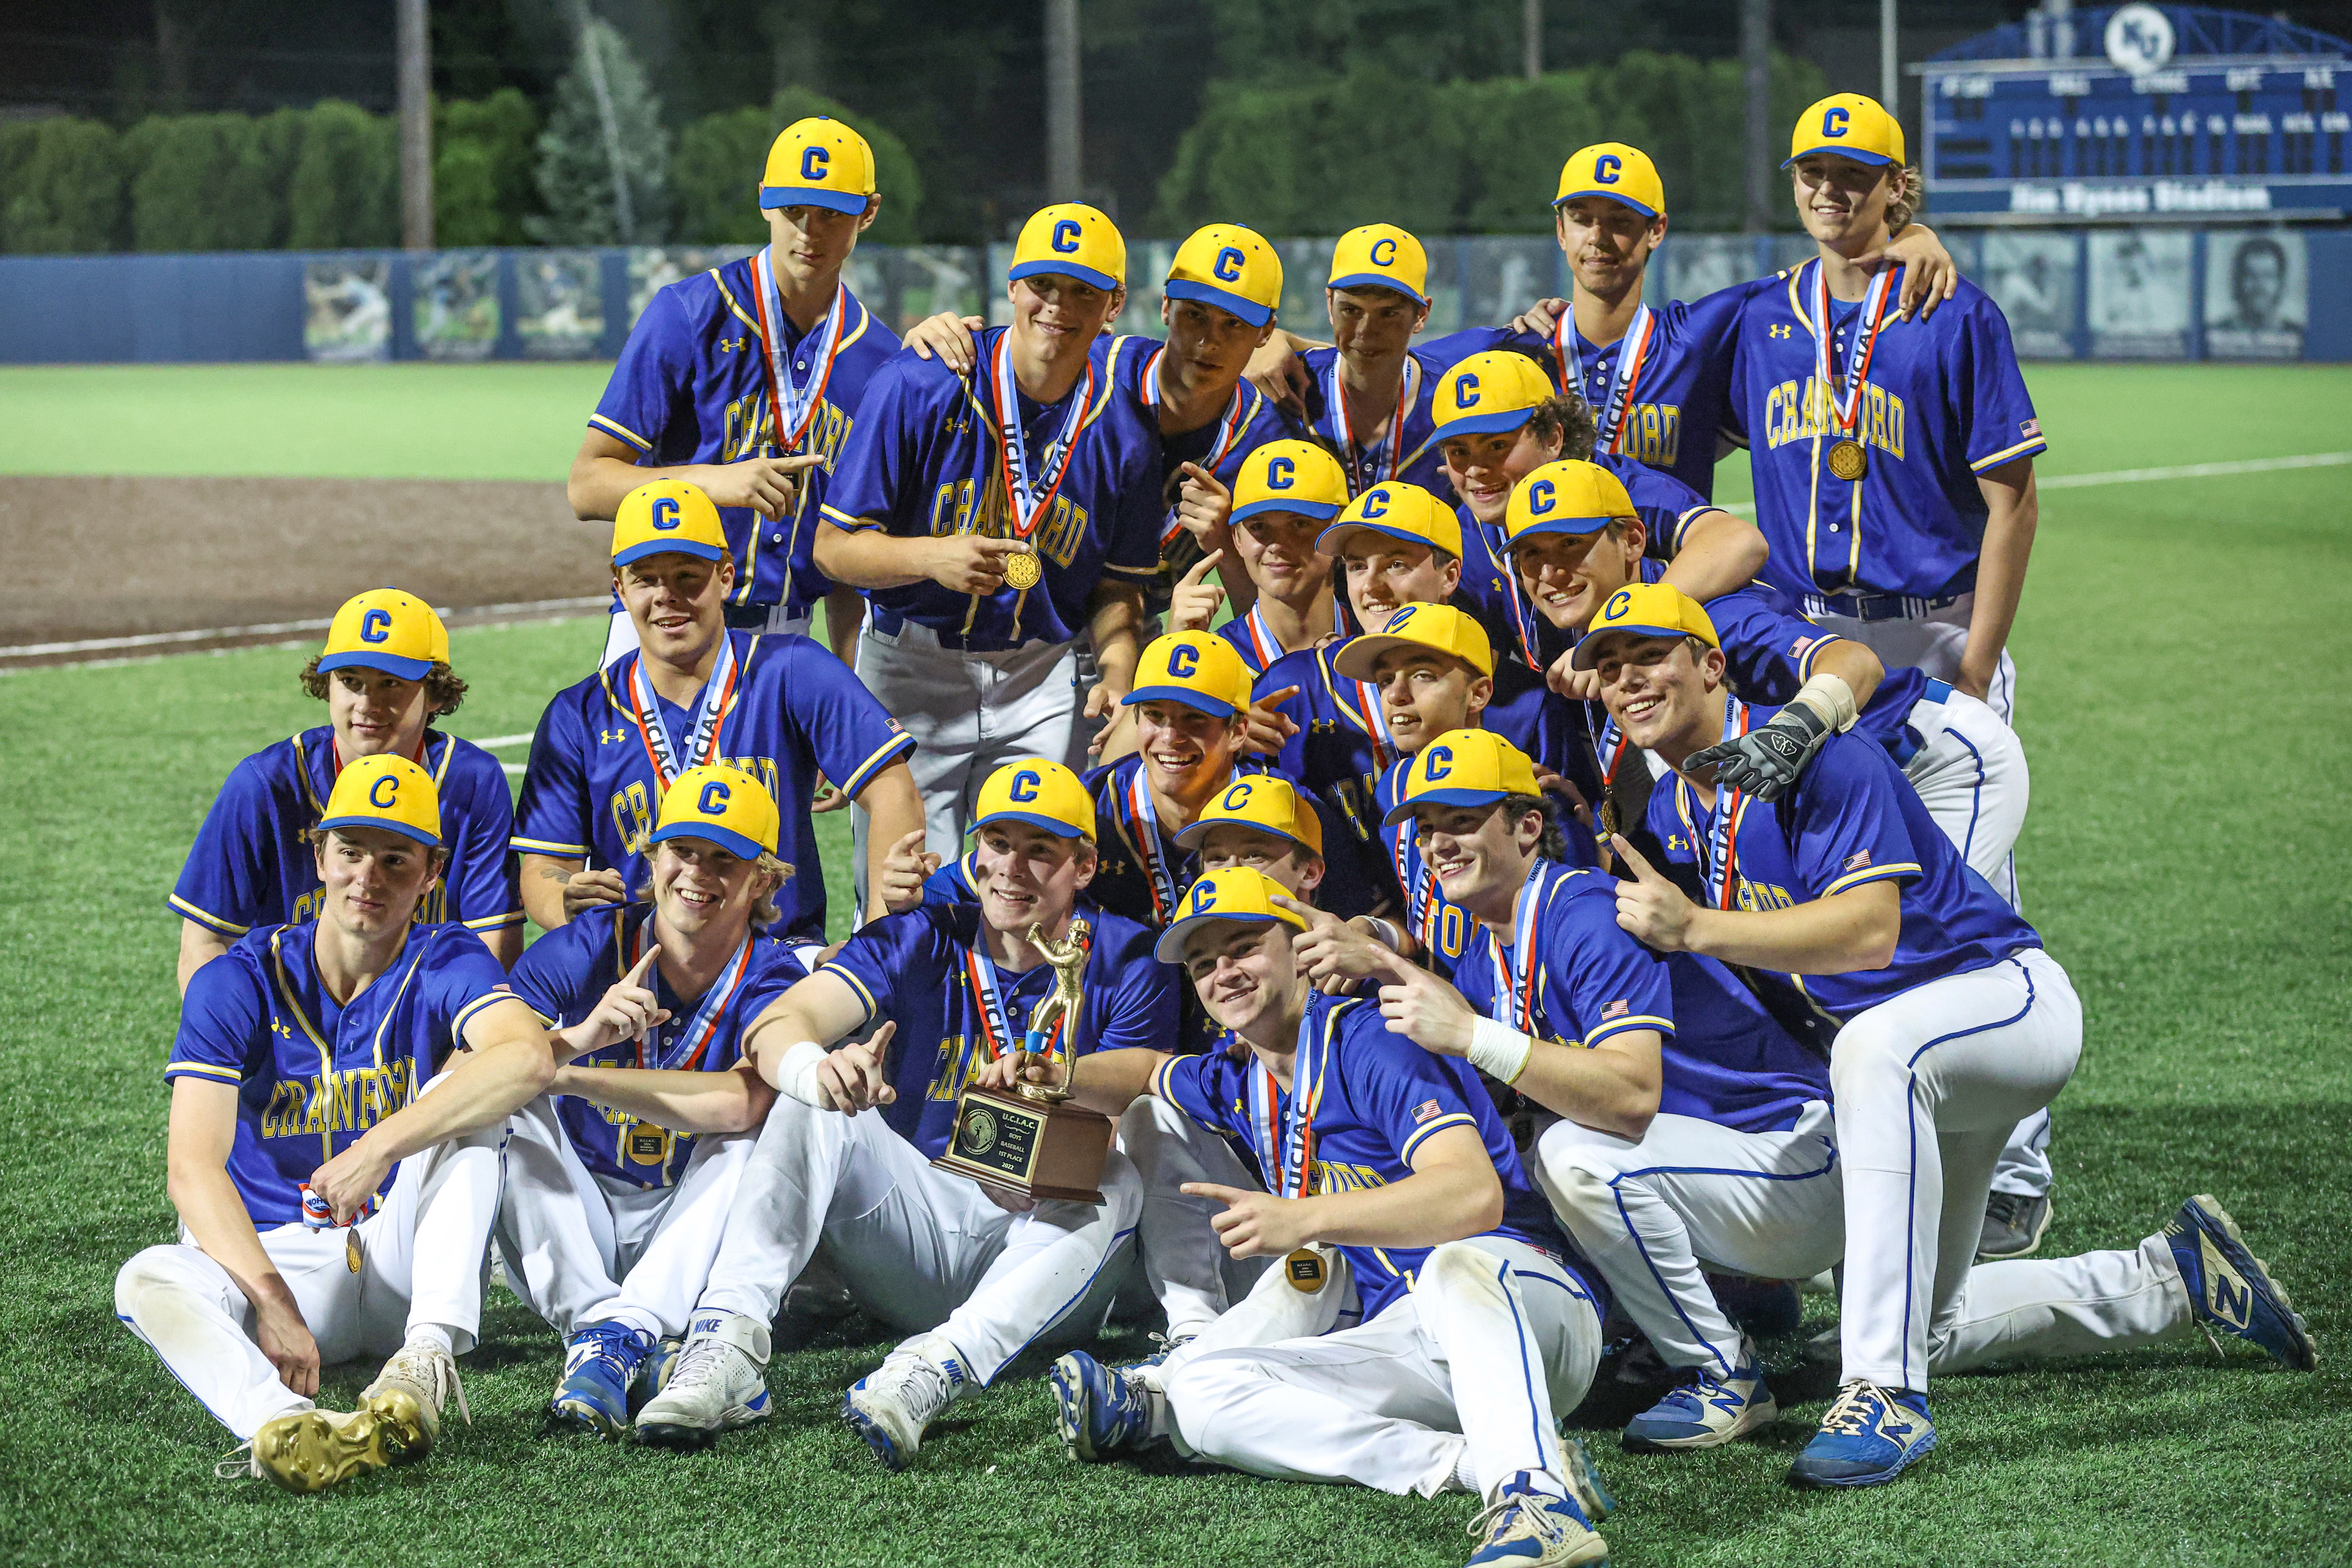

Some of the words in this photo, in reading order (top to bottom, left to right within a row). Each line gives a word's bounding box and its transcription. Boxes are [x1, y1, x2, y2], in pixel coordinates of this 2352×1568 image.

[1823, 107, 1849, 137] C
[801, 146, 828, 180] C
[1595, 155, 1621, 184] C
[1053, 220, 1081, 253] C
[1371, 239, 1396, 266] C
[1214, 247, 1244, 282] C
[1849, 316, 1876, 389] UCIAC
[1456, 374, 1480, 408] C
[1602, 371, 1633, 443] UCIAC
[1766, 374, 1905, 462] CRANORD
[1002, 424, 1025, 501] UCIAC
[1033, 432, 1074, 503] UCIAC
[1268, 457, 1294, 490] C
[652, 498, 679, 530] C
[1361, 490, 1390, 519] C
[1530, 480, 1555, 515] C
[931, 477, 1088, 569] CRANRD
[1605, 592, 1630, 620] C
[361, 609, 392, 643] C
[1168, 644, 1199, 678] C
[1726, 700, 1735, 722] UNION
[641, 709, 676, 779] UCIAC
[1425, 746, 1452, 781] C
[370, 775, 399, 808] C
[698, 781, 730, 815] C
[1010, 770, 1041, 802] C
[1224, 784, 1251, 810] C
[1713, 803, 1734, 886] UCIAC
[1528, 857, 1544, 882] UNION
[1191, 880, 1216, 913] C
[1415, 867, 1433, 924] UCIA
[1305, 994, 1316, 1016] UNION
[1514, 965, 1529, 1030] CIAC
[980, 989, 1009, 1058] UCIA
[261, 1055, 419, 1139] CRANFORD
[1002, 1113, 1036, 1129] U.C.I.A.C.
[1009, 1132, 1022, 1141] BOYS
[1000, 1141, 1025, 1153] BASEBALL
[1007, 1153, 1024, 1163] PLACE
[1288, 1102, 1309, 1190] UCIAC
[1001, 1162, 1014, 1171] 2022
[692, 1318, 722, 1336] NIKE
[940, 1358, 965, 1387] NIKE
